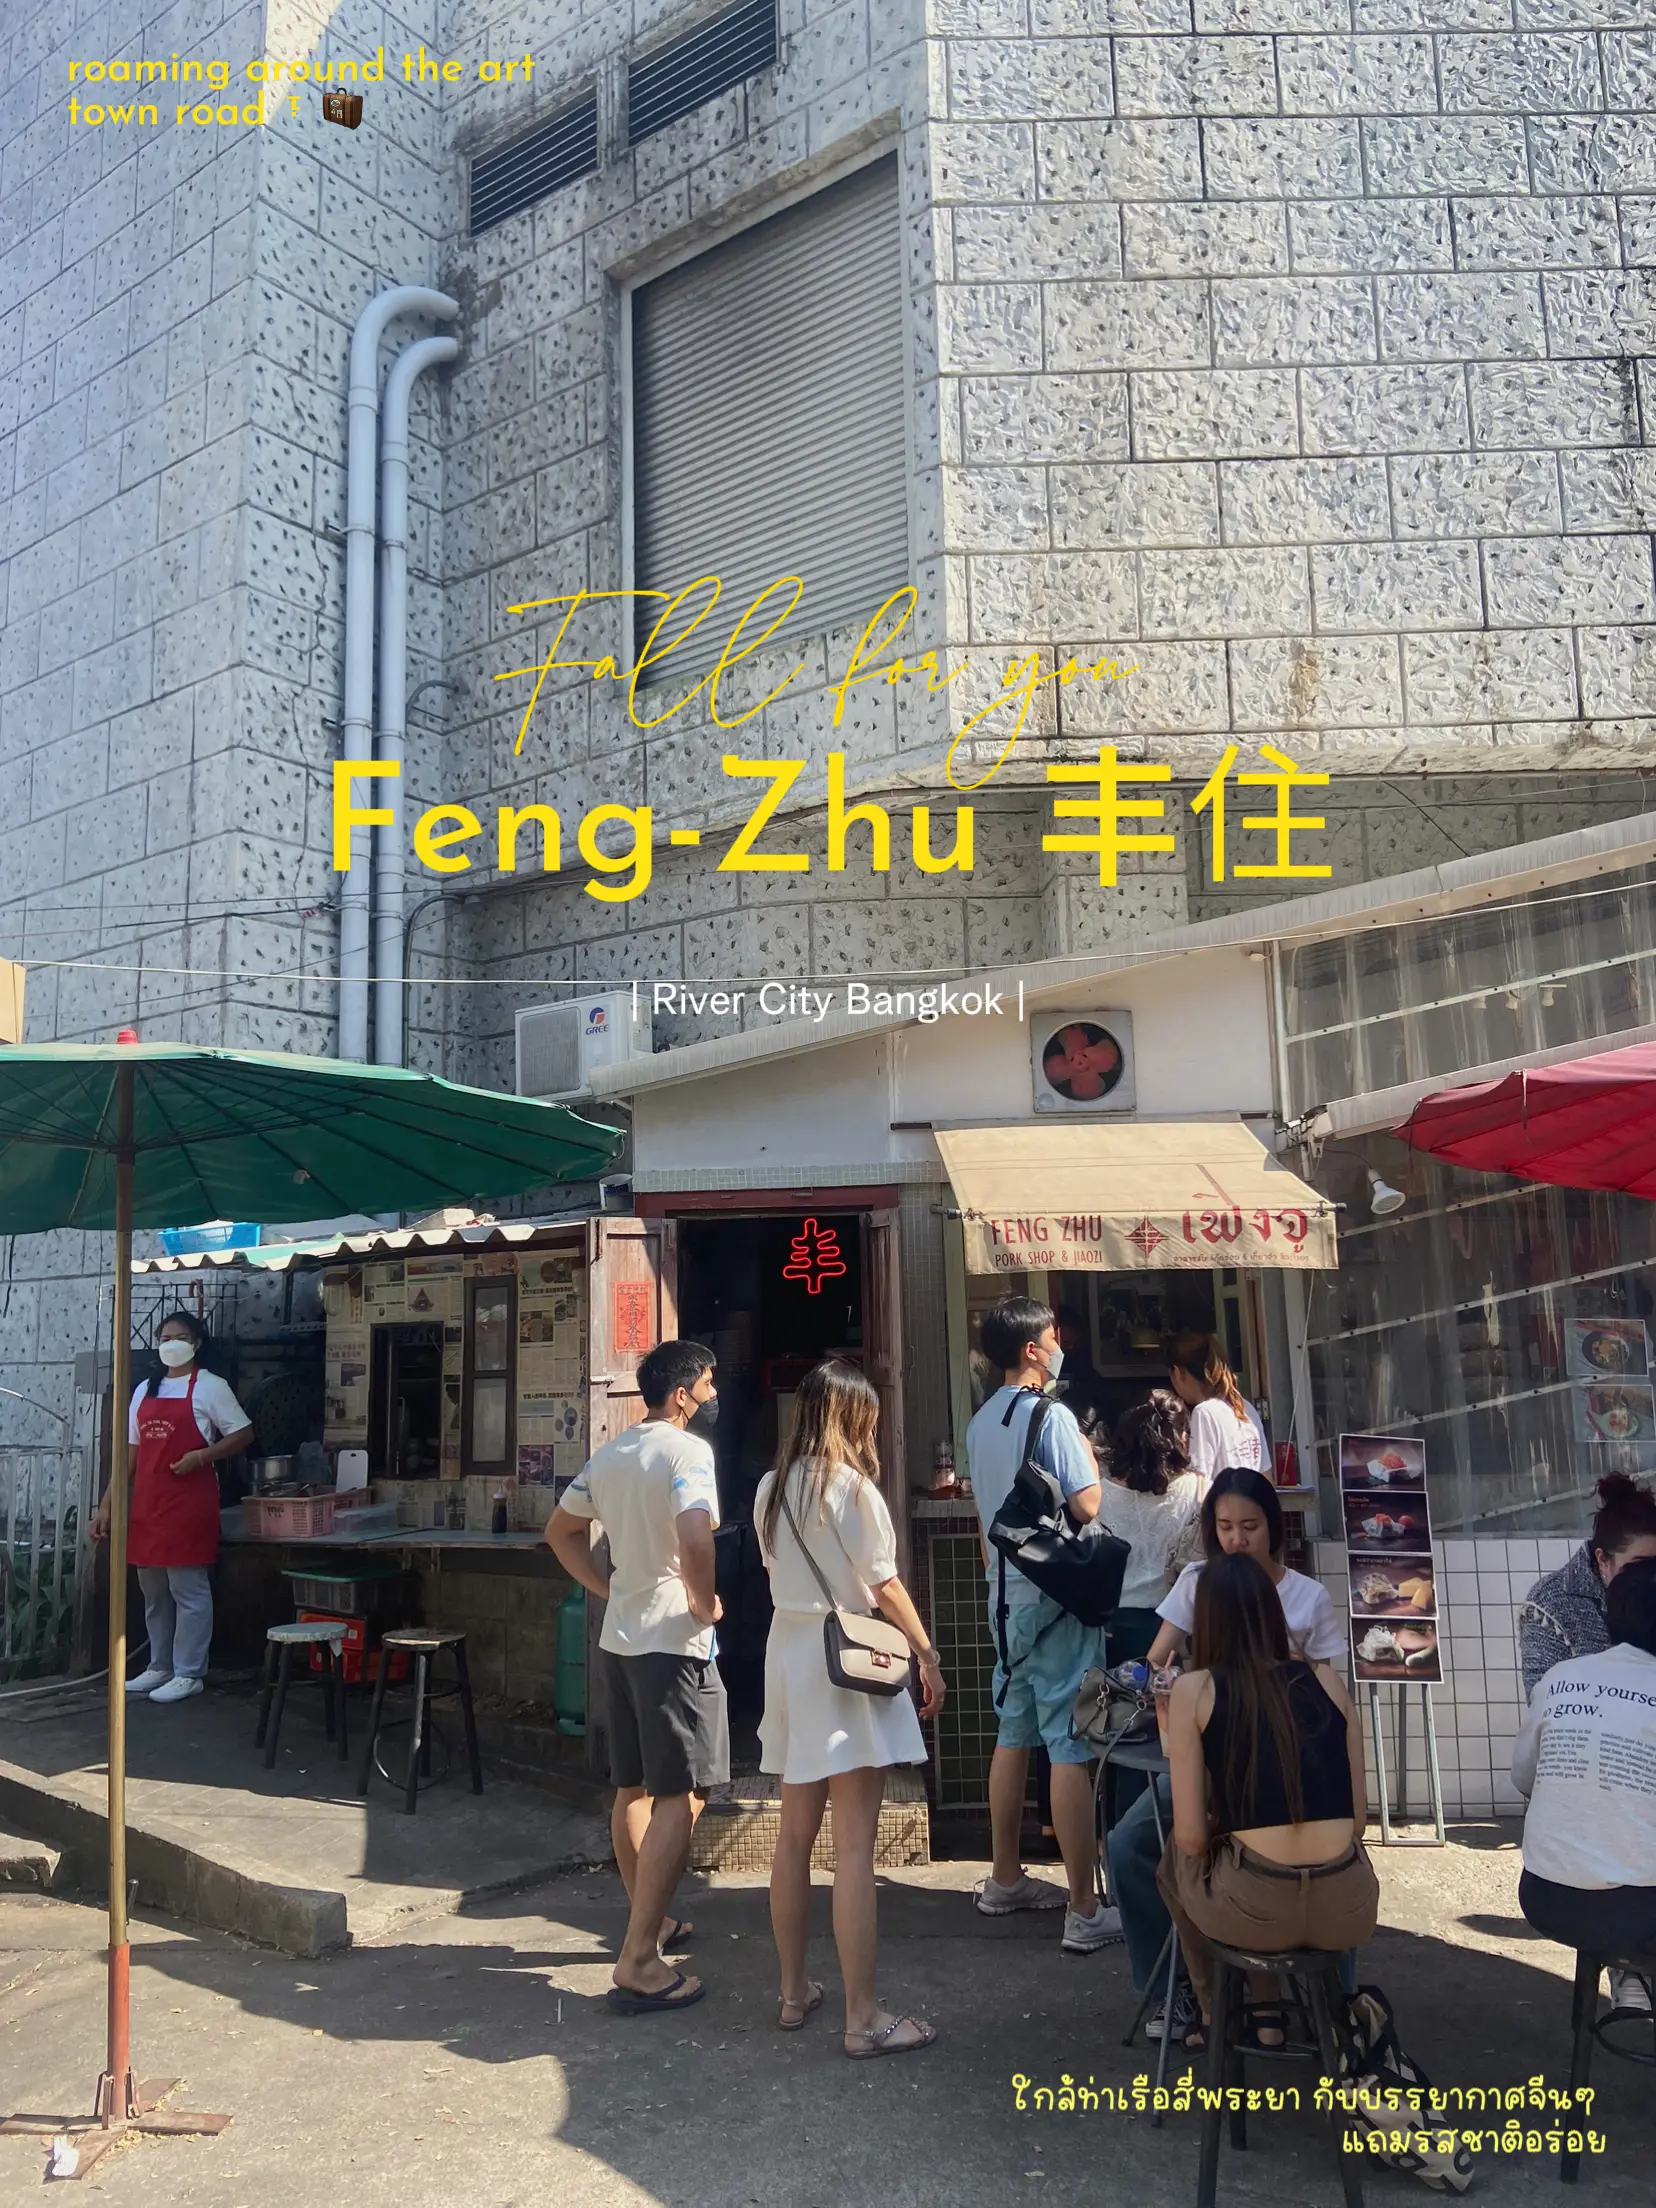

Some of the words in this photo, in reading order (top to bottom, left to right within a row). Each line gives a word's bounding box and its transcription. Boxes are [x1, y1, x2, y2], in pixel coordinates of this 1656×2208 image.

[585, 1024, 610, 1036] GREE
[990, 1216, 1049, 1246] FENG
[1061, 1215, 1103, 1242] ZHU
[995, 1252, 1023, 1267] PORK
[1028, 1250, 1056, 1265] SHOP
[1061, 1250, 1069, 1263] &
[1073, 1250, 1103, 1266] JIAOZI
[1546, 1680, 1591, 1699] Allow
[1553, 1702, 1604, 1719] grow.
